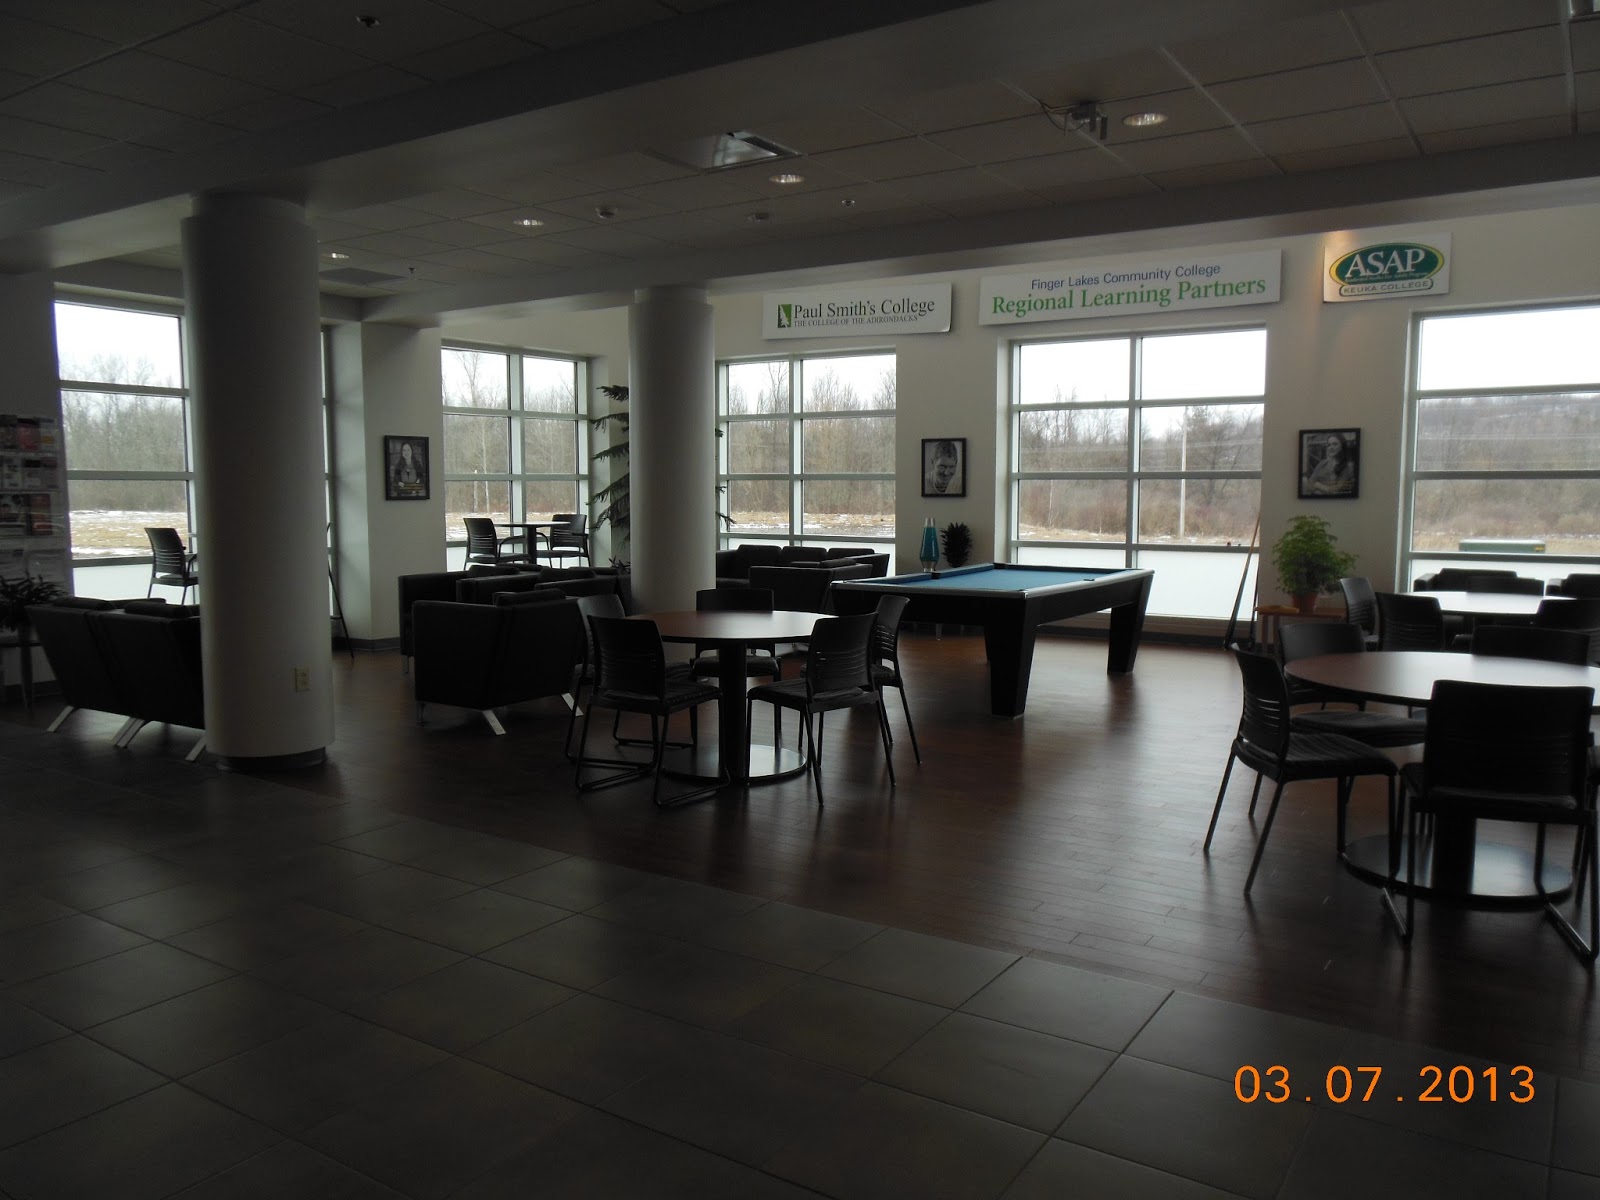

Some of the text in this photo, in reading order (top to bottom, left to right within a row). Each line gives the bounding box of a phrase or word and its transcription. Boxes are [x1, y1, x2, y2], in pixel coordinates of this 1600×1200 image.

[1345, 248, 1425, 278] ASAP
[1031, 264, 1221, 291] Finger Lakes Community College
[1344, 281, 1429, 293] KEUKA COLLEGE
[794, 298, 935, 319] Paul Smith's College
[992, 279, 1266, 318] Regional Learning Partners
[808, 319, 839, 327] COLLEGE
[851, 317, 866, 325] THE
[866, 315, 918, 324] ADIRONDACKS
